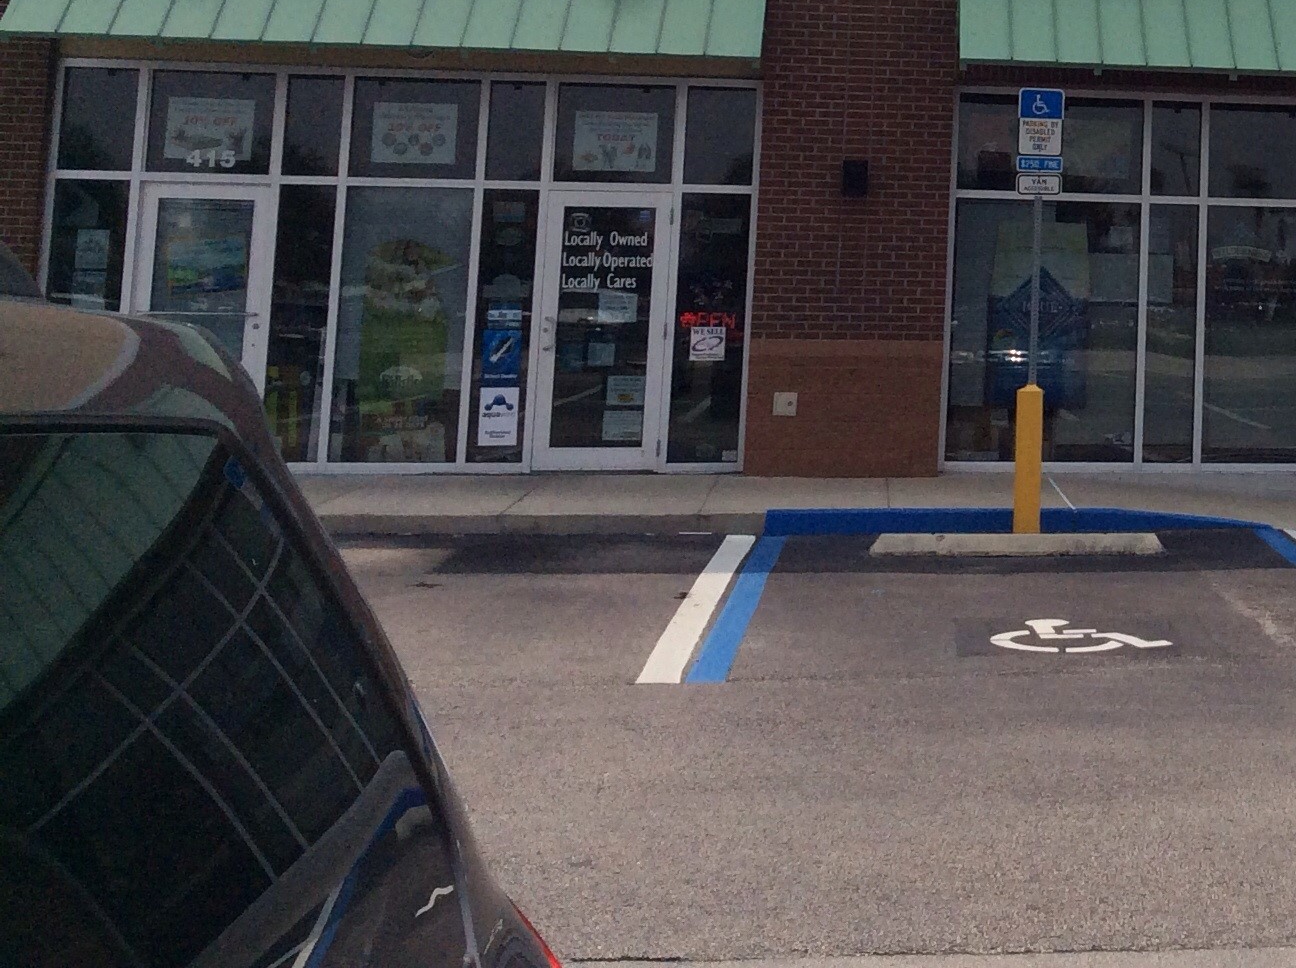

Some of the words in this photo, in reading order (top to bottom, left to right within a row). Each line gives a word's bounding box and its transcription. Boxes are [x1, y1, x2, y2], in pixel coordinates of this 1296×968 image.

[186, 150, 236, 168] 415
[564, 231, 603, 251] Locally
[610, 231, 648, 246] Owned
[562, 252, 601, 271] Locally
[603, 251, 654, 272] Operated
[561, 273, 600, 292] Locally
[607, 273, 637, 288] Cares
